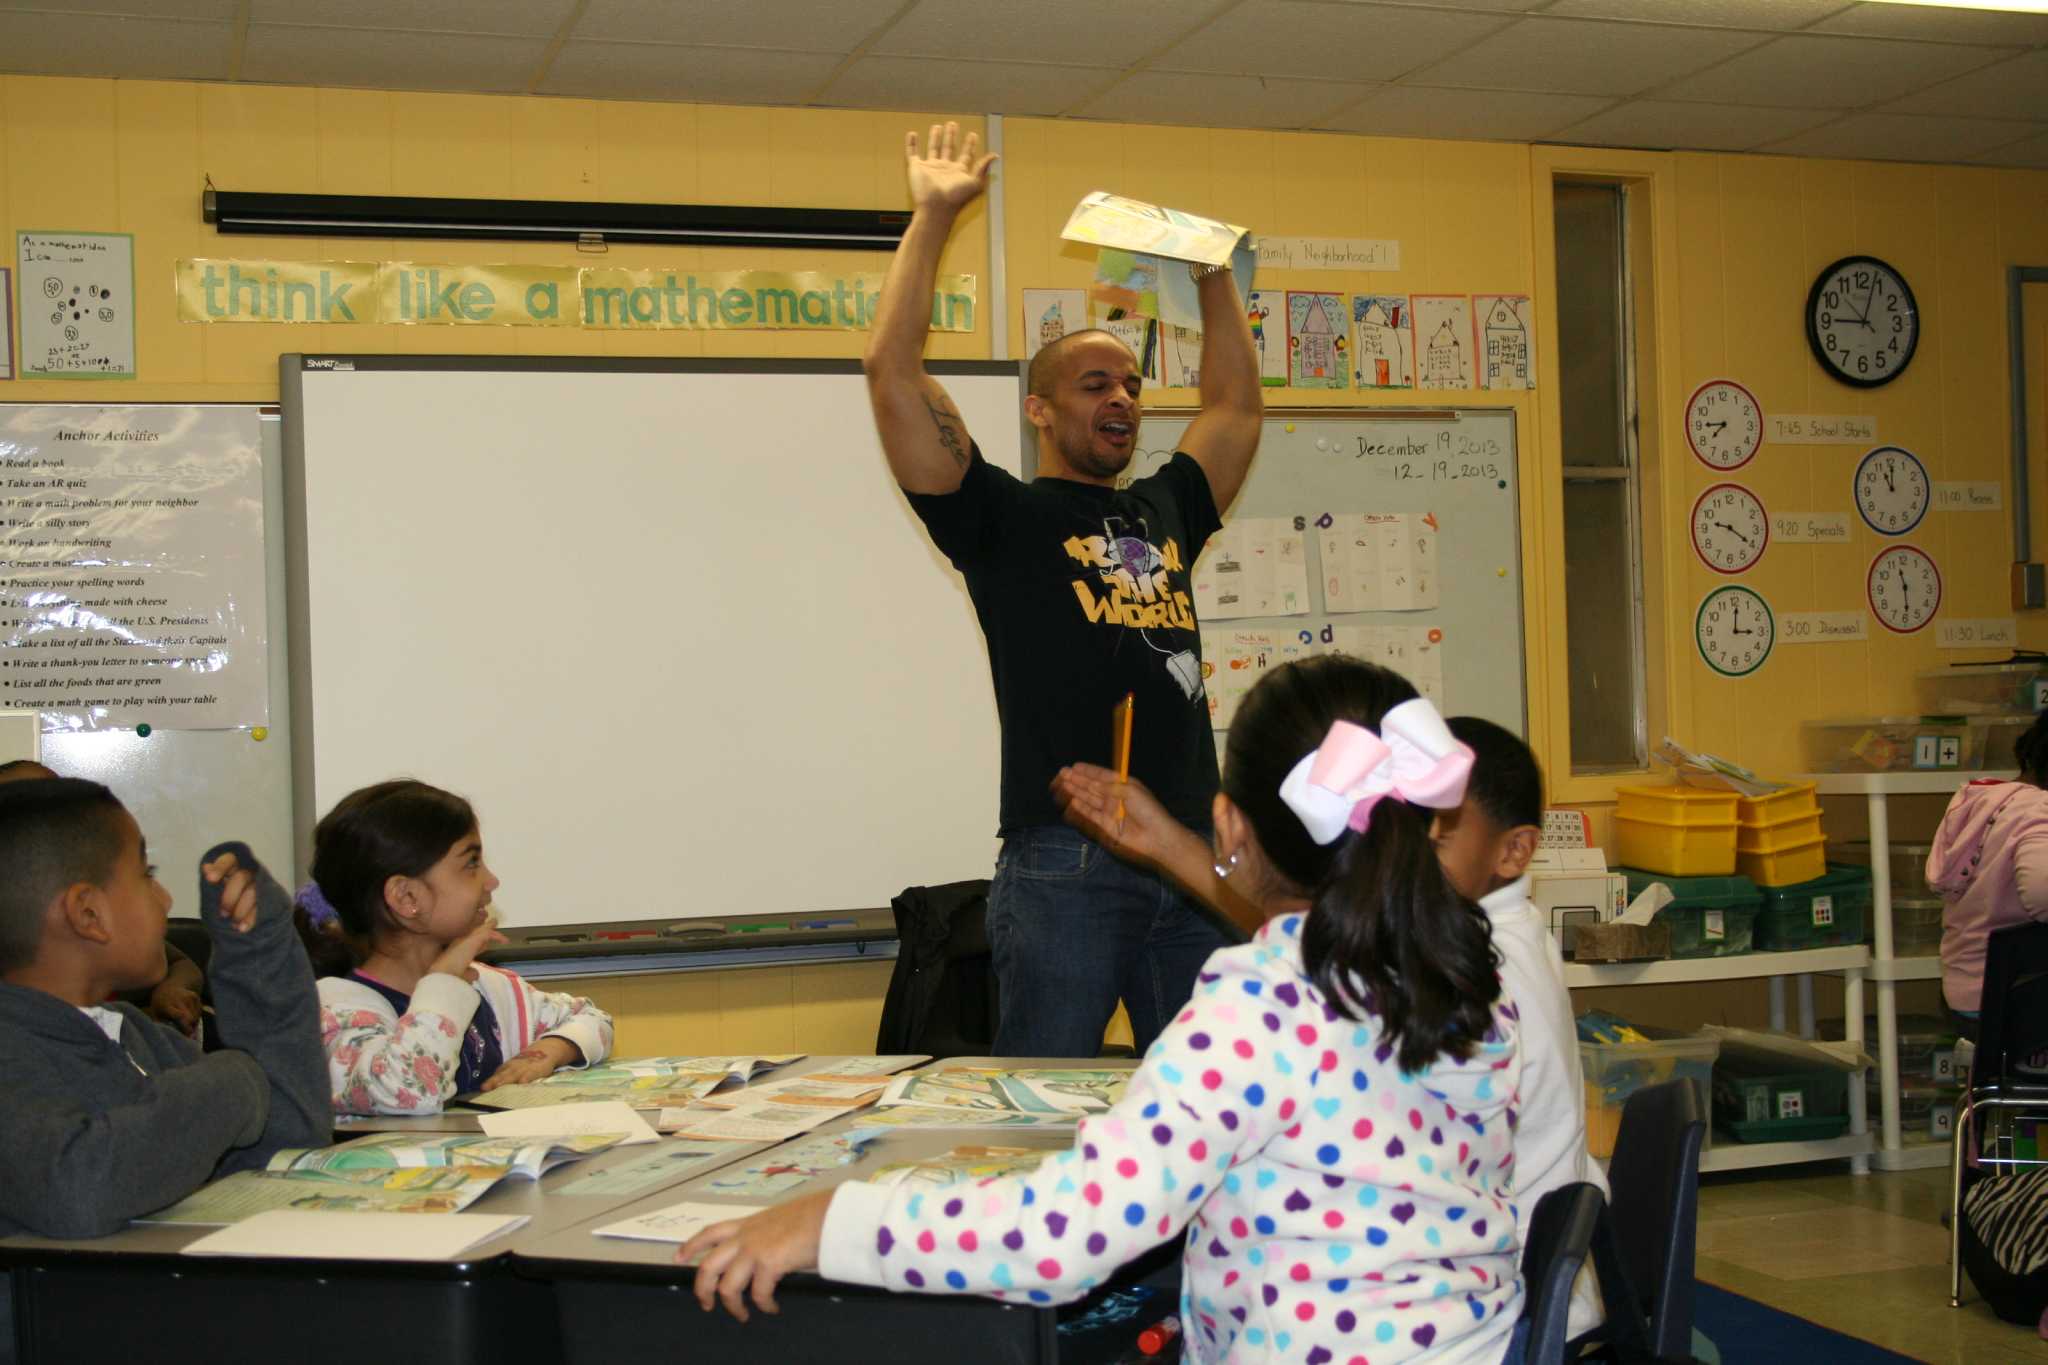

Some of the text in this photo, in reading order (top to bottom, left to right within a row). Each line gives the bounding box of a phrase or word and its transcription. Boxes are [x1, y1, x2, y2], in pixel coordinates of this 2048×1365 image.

[1838, 277, 1850, 294] 11
[1852, 272, 1870, 290] 12
[1876, 278, 1882, 296] 1
[201, 265, 973, 329] think like a mathematin
[1822, 291, 1839, 309] 10
[1887, 295, 1898, 312] 2
[1821, 312, 1831, 330] 9
[1892, 316, 1903, 333] 3
[1826, 334, 1837, 351] 8
[1888, 336, 1899, 353] 4
[307, 360, 334, 368] SMART
[1840, 350, 1850, 367] 7
[1875, 351, 1886, 369] 5
[1858, 355, 1868, 374] 6
[1707, 396, 1714, 405] 11
[1719, 391, 1727, 401] 12
[1698, 406, 1708, 416] 10
[1743, 405, 1750, 416] 2
[1696, 420, 1702, 431] 9
[1747, 420, 1754, 431] 3
[54, 430, 160, 441] Anchor Activities
[1700, 436, 1706, 446] 8
[1743, 435, 1750, 445] 4
[1356, 435, 1429, 458] December
[1458, 436, 1501, 456] 2013
[1711, 446, 1716, 456] 7
[1734, 446, 1741, 457] 5
[1722, 450, 1729, 461] 6
[6, 460, 30, 468] Read
[1875, 463, 1882, 472] 11
[1866, 472, 1876, 483] 10
[1911, 472, 1917, 481] 2
[7, 479, 31, 488] Take
[49, 479, 64, 487] AR
[67, 479, 87, 490] quiz
[1864, 486, 1871, 497] 9
[1914, 486, 1920, 497] 3
[7, 500, 33, 508] Write
[114, 499, 129, 509] for
[131, 500, 153, 509] your
[155, 498, 199, 508] neighbor
[1713, 498, 1721, 509] 11
[1725, 494, 1734, 504] 12
[1868, 501, 1875, 512] 8
[1910, 501, 1917, 510] 4
[1704, 509, 1714, 520] 10
[1750, 509, 1756, 519] 2
[1879, 512, 1885, 520] 7
[1902, 511, 1909, 522] 5
[8, 519, 90, 529] Write silly story
[1889, 515, 1896, 525] 6
[1701, 523, 1708, 534] 9
[1753, 524, 1759, 535] 3
[8, 539, 34, 547] Work
[52, 538, 112, 548] handwriting
[1705, 539, 1712, 549] 8
[1749, 540, 1755, 549] 4
[1716, 549, 1722, 559] 7
[1727, 554, 1733, 564] 6
[1740, 550, 1746, 560] 5
[9, 560, 41, 568] Create
[1888, 560, 1895, 569] 11
[1899, 555, 1908, 565] 12
[1880, 571, 1889, 581] 10
[1923, 569, 1929, 579] 2
[10, 577, 144, 589] Practice your spelling words
[1100, 567, 1170, 604] THE
[1877, 585, 1884, 595] 9
[1926, 584, 1933, 594] 3
[113, 597, 133, 606] with
[137, 598, 168, 606] cheese
[1718, 601, 1726, 611] 11
[1730, 596, 1739, 607] 12
[1881, 599, 1888, 609] 8
[1923, 598, 1929, 608] 4
[1709, 611, 1719, 622] 10
[1755, 610, 1761, 622] 2
[1890, 609, 1897, 620] 7
[1902, 614, 1909, 623] 6
[1914, 609, 1920, 619] 5
[119, 617, 134, 625] the
[160, 616, 208, 625] Presidents
[1706, 625, 1713, 636] 9
[1758, 626, 1765, 637] 3
[17, 640, 38, 648] ake
[50, 638, 65, 647] list
[67, 638, 77, 649] of
[80, 638, 94, 647] all
[96, 638, 109, 647] the
[189, 635, 228, 646] Capitals
[1710, 641, 1716, 651] 8
[1754, 641, 1760, 650] 4
[12, 659, 38, 668] Write
[50, 657, 99, 668] thank-you
[102, 657, 126, 667] letter
[129, 658, 138, 667] to
[1721, 652, 1727, 662] 7
[1731, 655, 1738, 666] 6
[1744, 652, 1751, 662] 5
[13, 677, 161, 689] List all the foods that are green
[13, 699, 46, 708] Create
[56, 698, 82, 708] math
[84, 701, 110, 710] game
[112, 699, 122, 707] to
[124, 697, 144, 708] play
[147, 697, 167, 705] with
[169, 698, 192, 707] your
[193, 696, 217, 704] table
[1940, 1059, 1949, 1074] 8
[1938, 1115, 1948, 1129] 9
